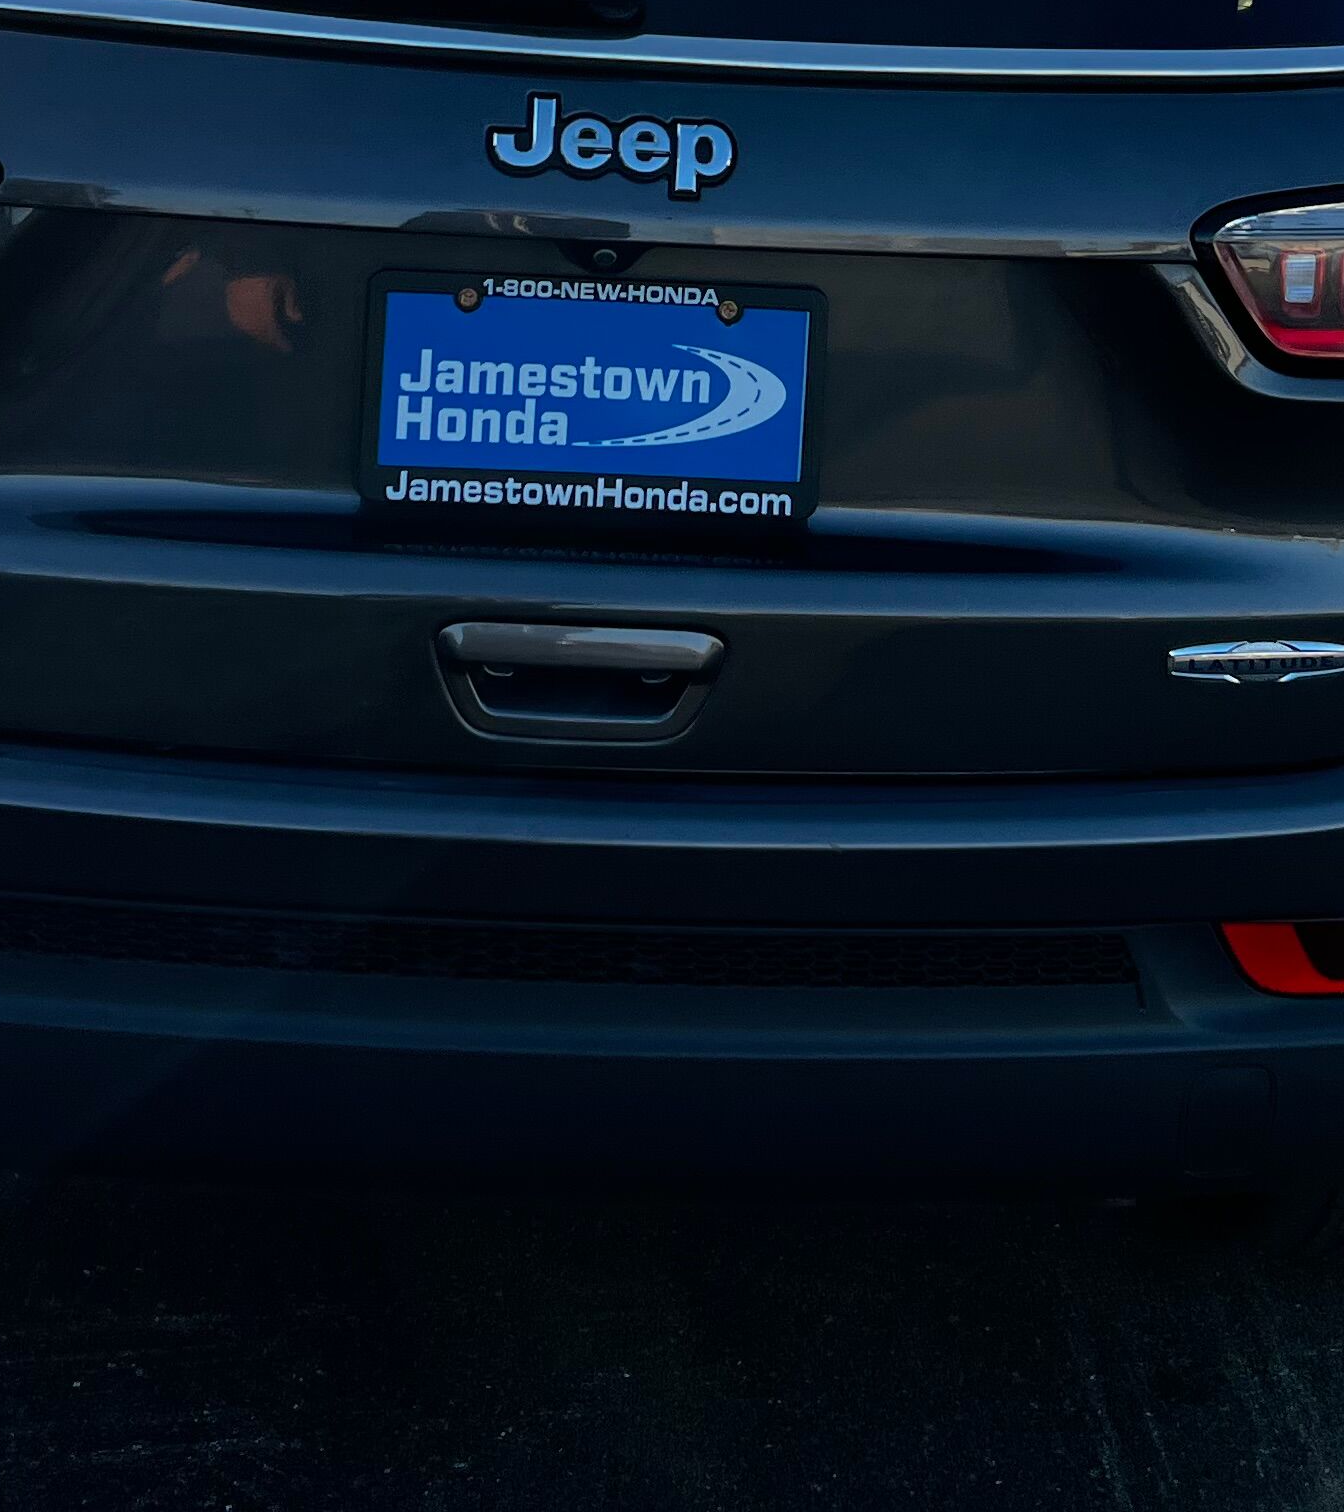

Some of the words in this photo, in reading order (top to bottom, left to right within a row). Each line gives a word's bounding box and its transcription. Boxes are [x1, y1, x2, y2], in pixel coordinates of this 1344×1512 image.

[490, 94, 736, 195] Jeep
[482, 278, 720, 307] 1-800-NEW-HONDA
[399, 348, 711, 405] Jamestown
[395, 396, 568, 446] Honda
[385, 470, 792, 517] JamestownHonda.com
[1188, 656, 1335, 671] LATITUDE
